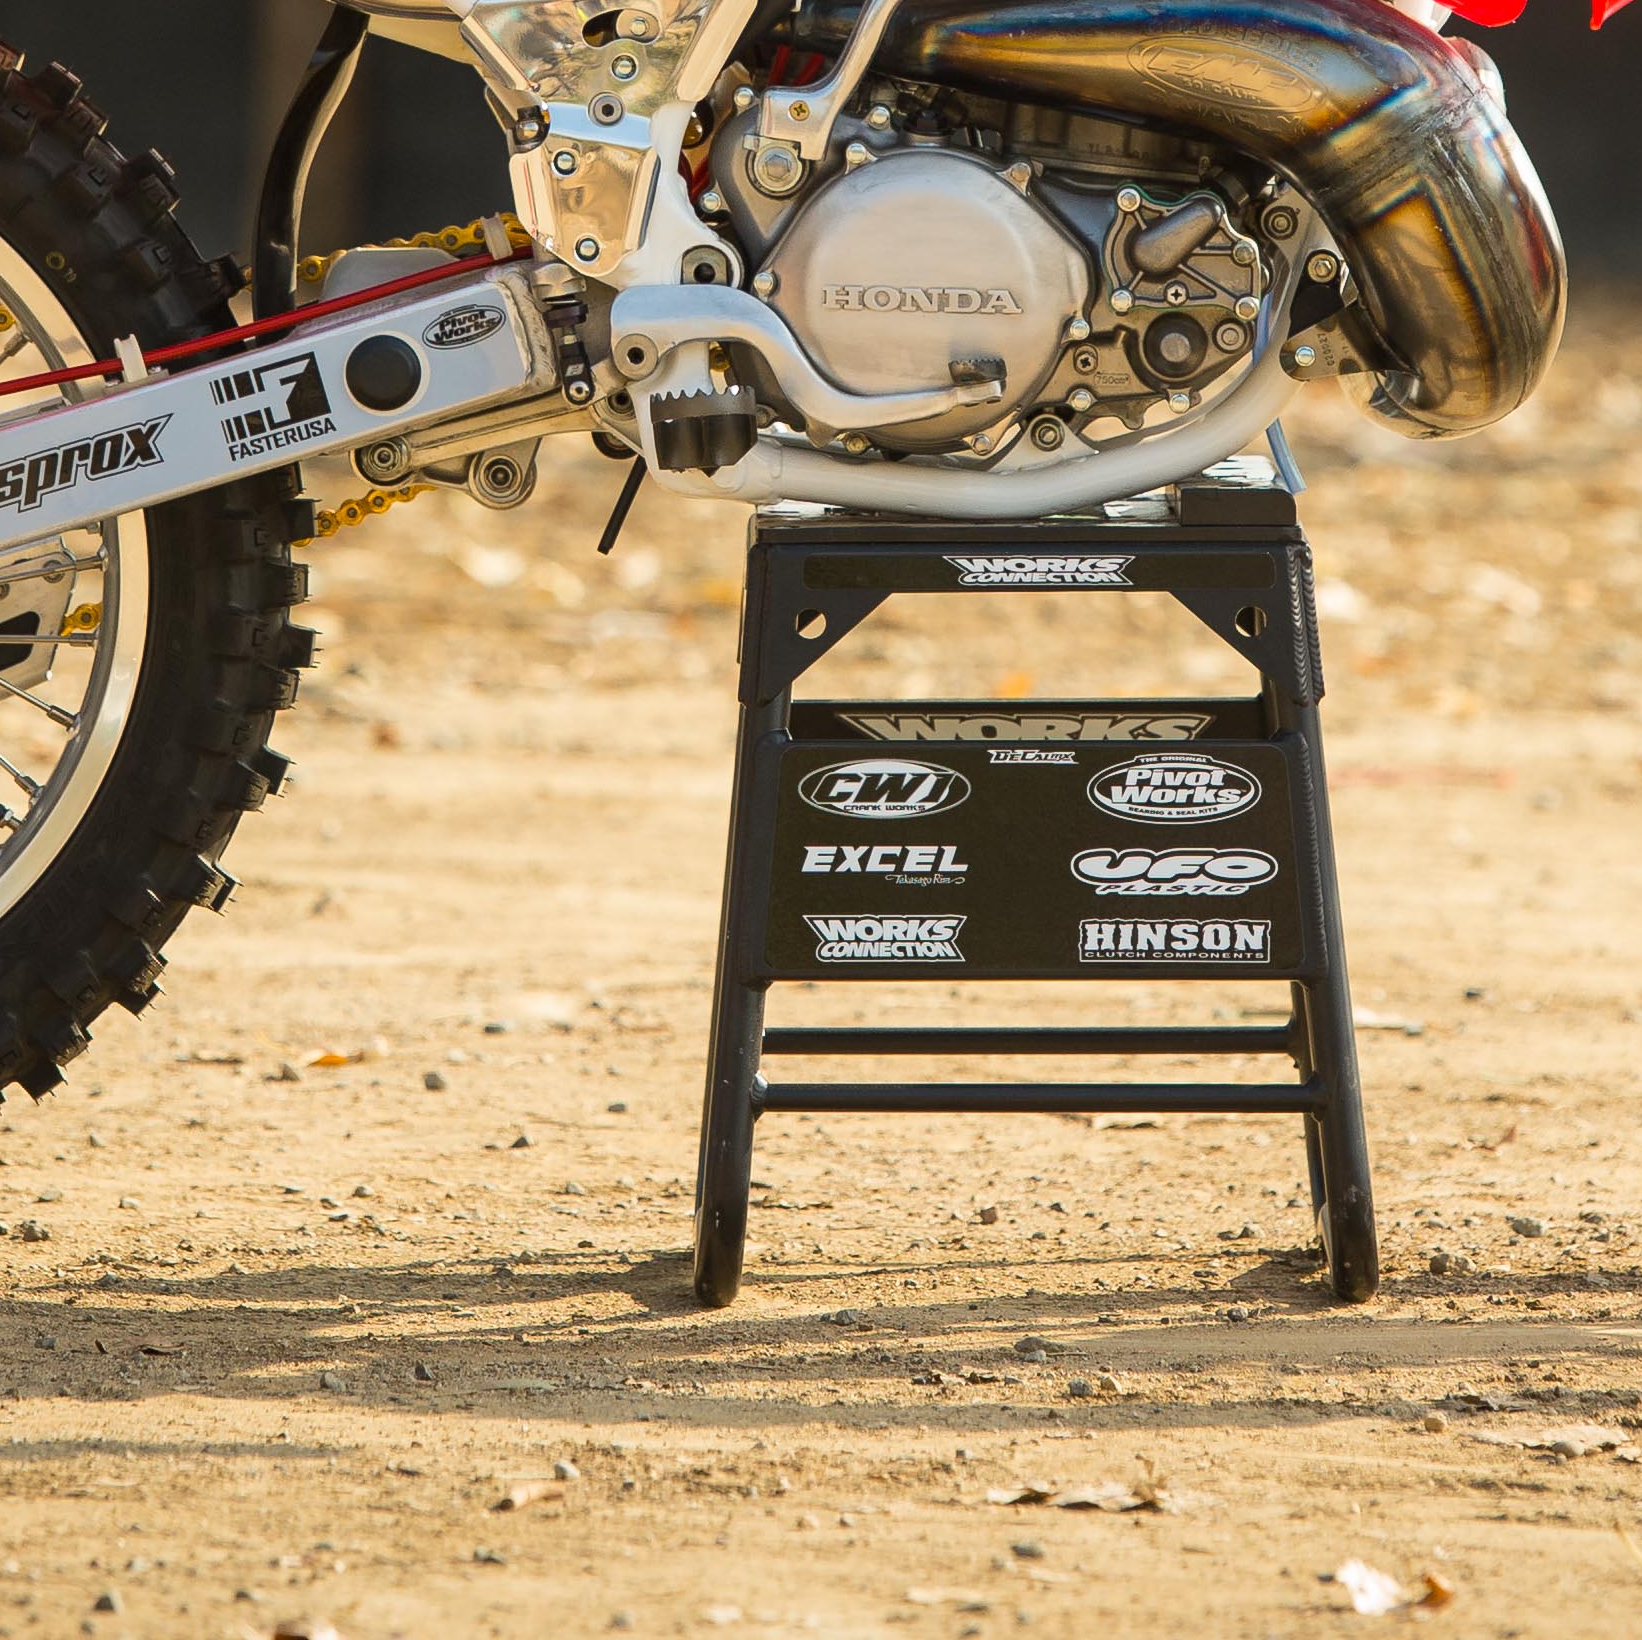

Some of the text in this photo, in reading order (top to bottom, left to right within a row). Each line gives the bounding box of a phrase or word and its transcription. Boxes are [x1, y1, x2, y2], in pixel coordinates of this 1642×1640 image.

[822, 285, 1024, 314] HONDA
[433, 317, 499, 342] Works
[438, 310, 487, 331] Pivot
[228, 417, 337, 461] FASTERUSA
[955, 558, 1126, 572] WORKS
[963, 573, 1124, 583] CONNECTION
[867, 717, 1199, 740] WORKS
[1125, 768, 1227, 786] Pivot
[1111, 786, 1242, 804] Works
[801, 845, 969, 872] EXCEL
[1078, 855, 1271, 879] UFO
[1099, 884, 1246, 893] PLASTIC
[813, 919, 959, 941] WORKS
[1084, 923, 1265, 950] HINSON
[820, 941, 956, 958] CONNECTION
[1153, 951, 1264, 959] COMPONENTS
